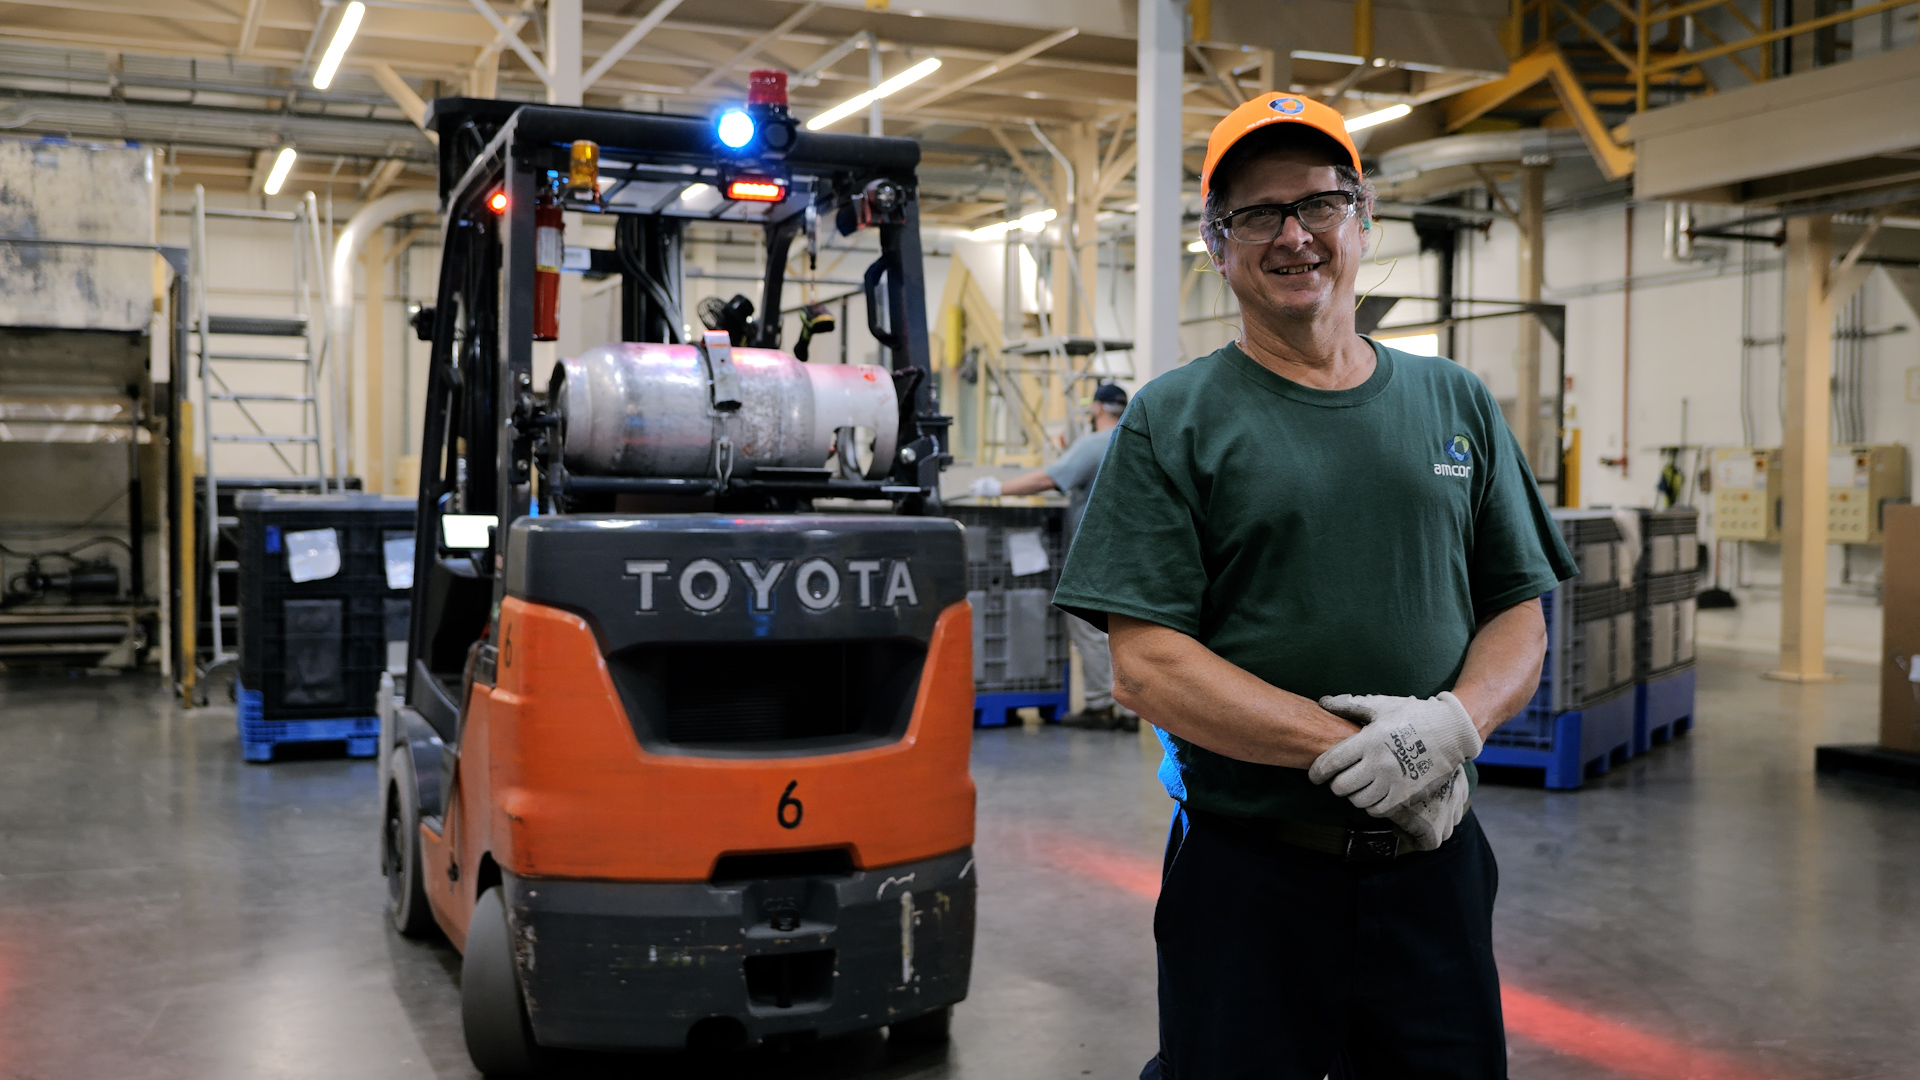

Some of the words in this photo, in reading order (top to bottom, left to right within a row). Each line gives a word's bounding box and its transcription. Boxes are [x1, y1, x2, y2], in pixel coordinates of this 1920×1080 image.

[1433, 463, 1471, 478] amcor
[624, 558, 920, 613] TOYOTA
[503, 622, 513, 668] 6
[1390, 733, 1419, 780] Condor
[777, 780, 803, 829] 6
